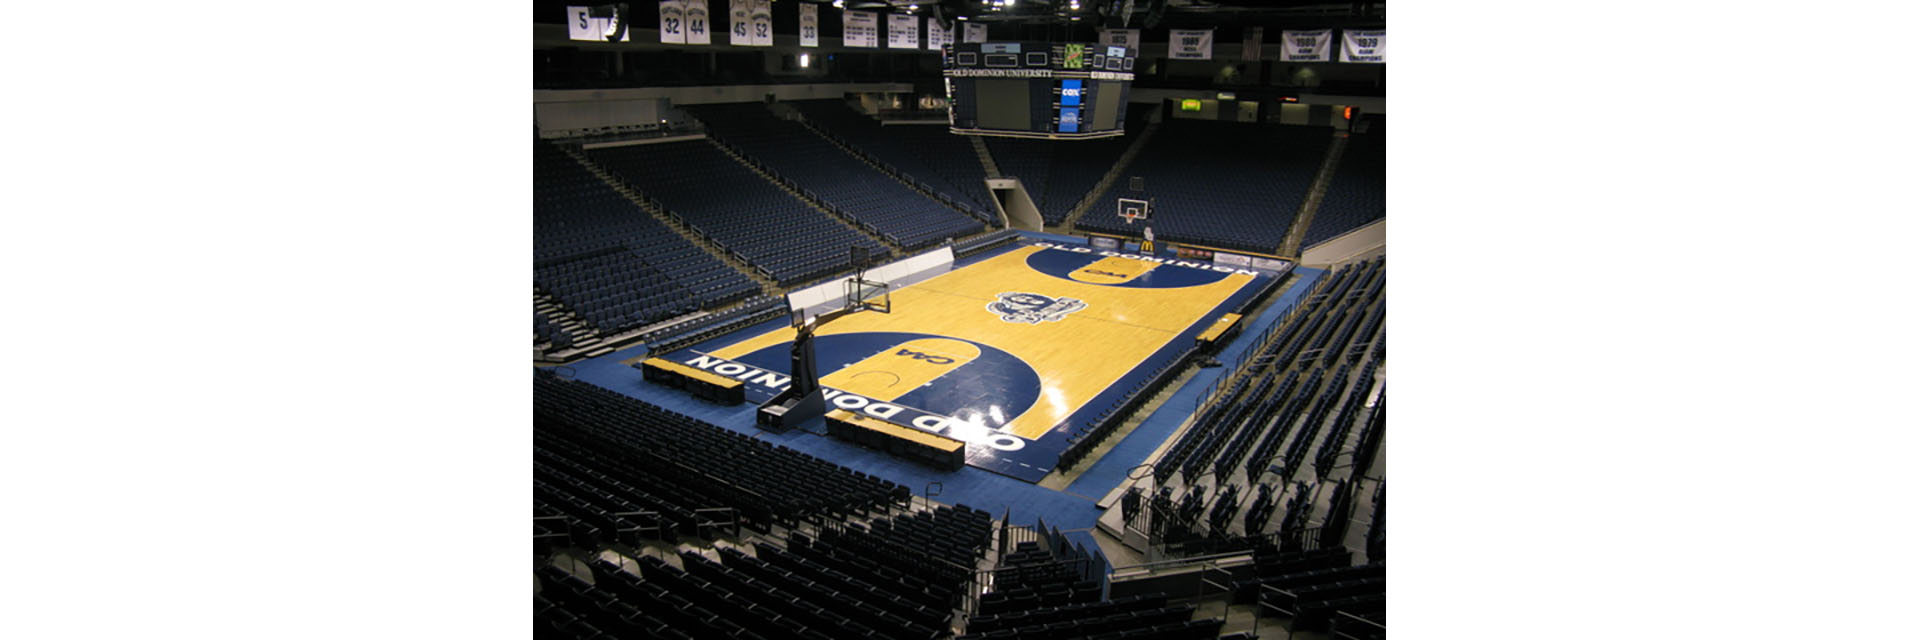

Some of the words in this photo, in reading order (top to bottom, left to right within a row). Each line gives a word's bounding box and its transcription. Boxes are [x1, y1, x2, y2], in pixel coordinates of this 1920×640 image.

[579, 11, 588, 30] 5
[665, 17, 680, 34] 32
[690, 19, 704, 35] 44
[734, 21, 746, 37] 45
[756, 22, 767, 38] 52
[803, 25, 815, 39] 33
[1358, 37, 1378, 48] 1979
[953, 69, 968, 77] OLD
[969, 69, 1005, 77] DOMINION
[1007, 69, 1052, 78] UNIVERSITY
[1035, 242, 1091, 253] OLD
[1100, 250, 1259, 276] DOMINION
[1083, 269, 1127, 278] CAA
[895, 349, 955, 365] CAA
[685, 355, 905, 419] DONION
[912, 415, 1025, 451] OD
